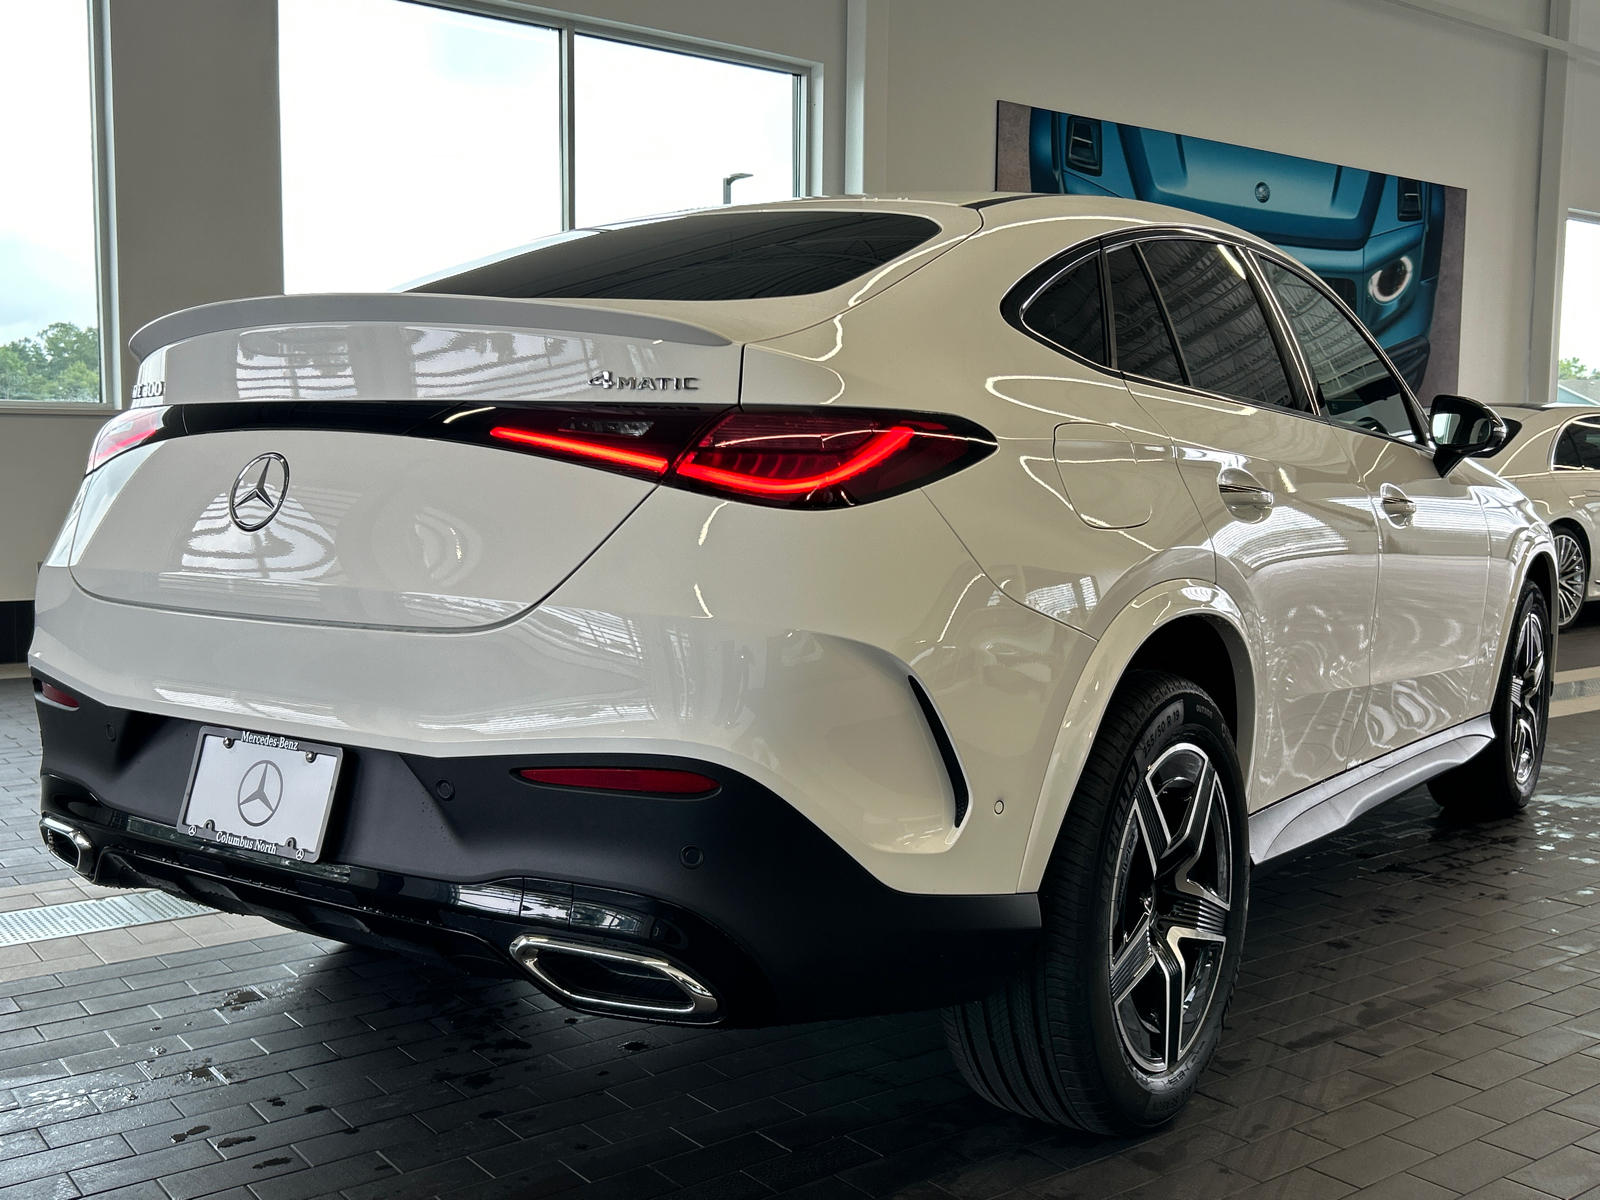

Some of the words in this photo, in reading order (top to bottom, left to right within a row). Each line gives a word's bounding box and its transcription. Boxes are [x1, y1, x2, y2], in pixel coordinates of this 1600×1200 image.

[587, 370, 700, 390] 4MATIC
[1172, 709, 1180, 723] 19
[240, 730, 300, 751] Mercedes-Benz
[216, 831, 253, 849] Columbus
[254, 839, 278, 855] North
[1099, 764, 1138, 905] MICHELIN
